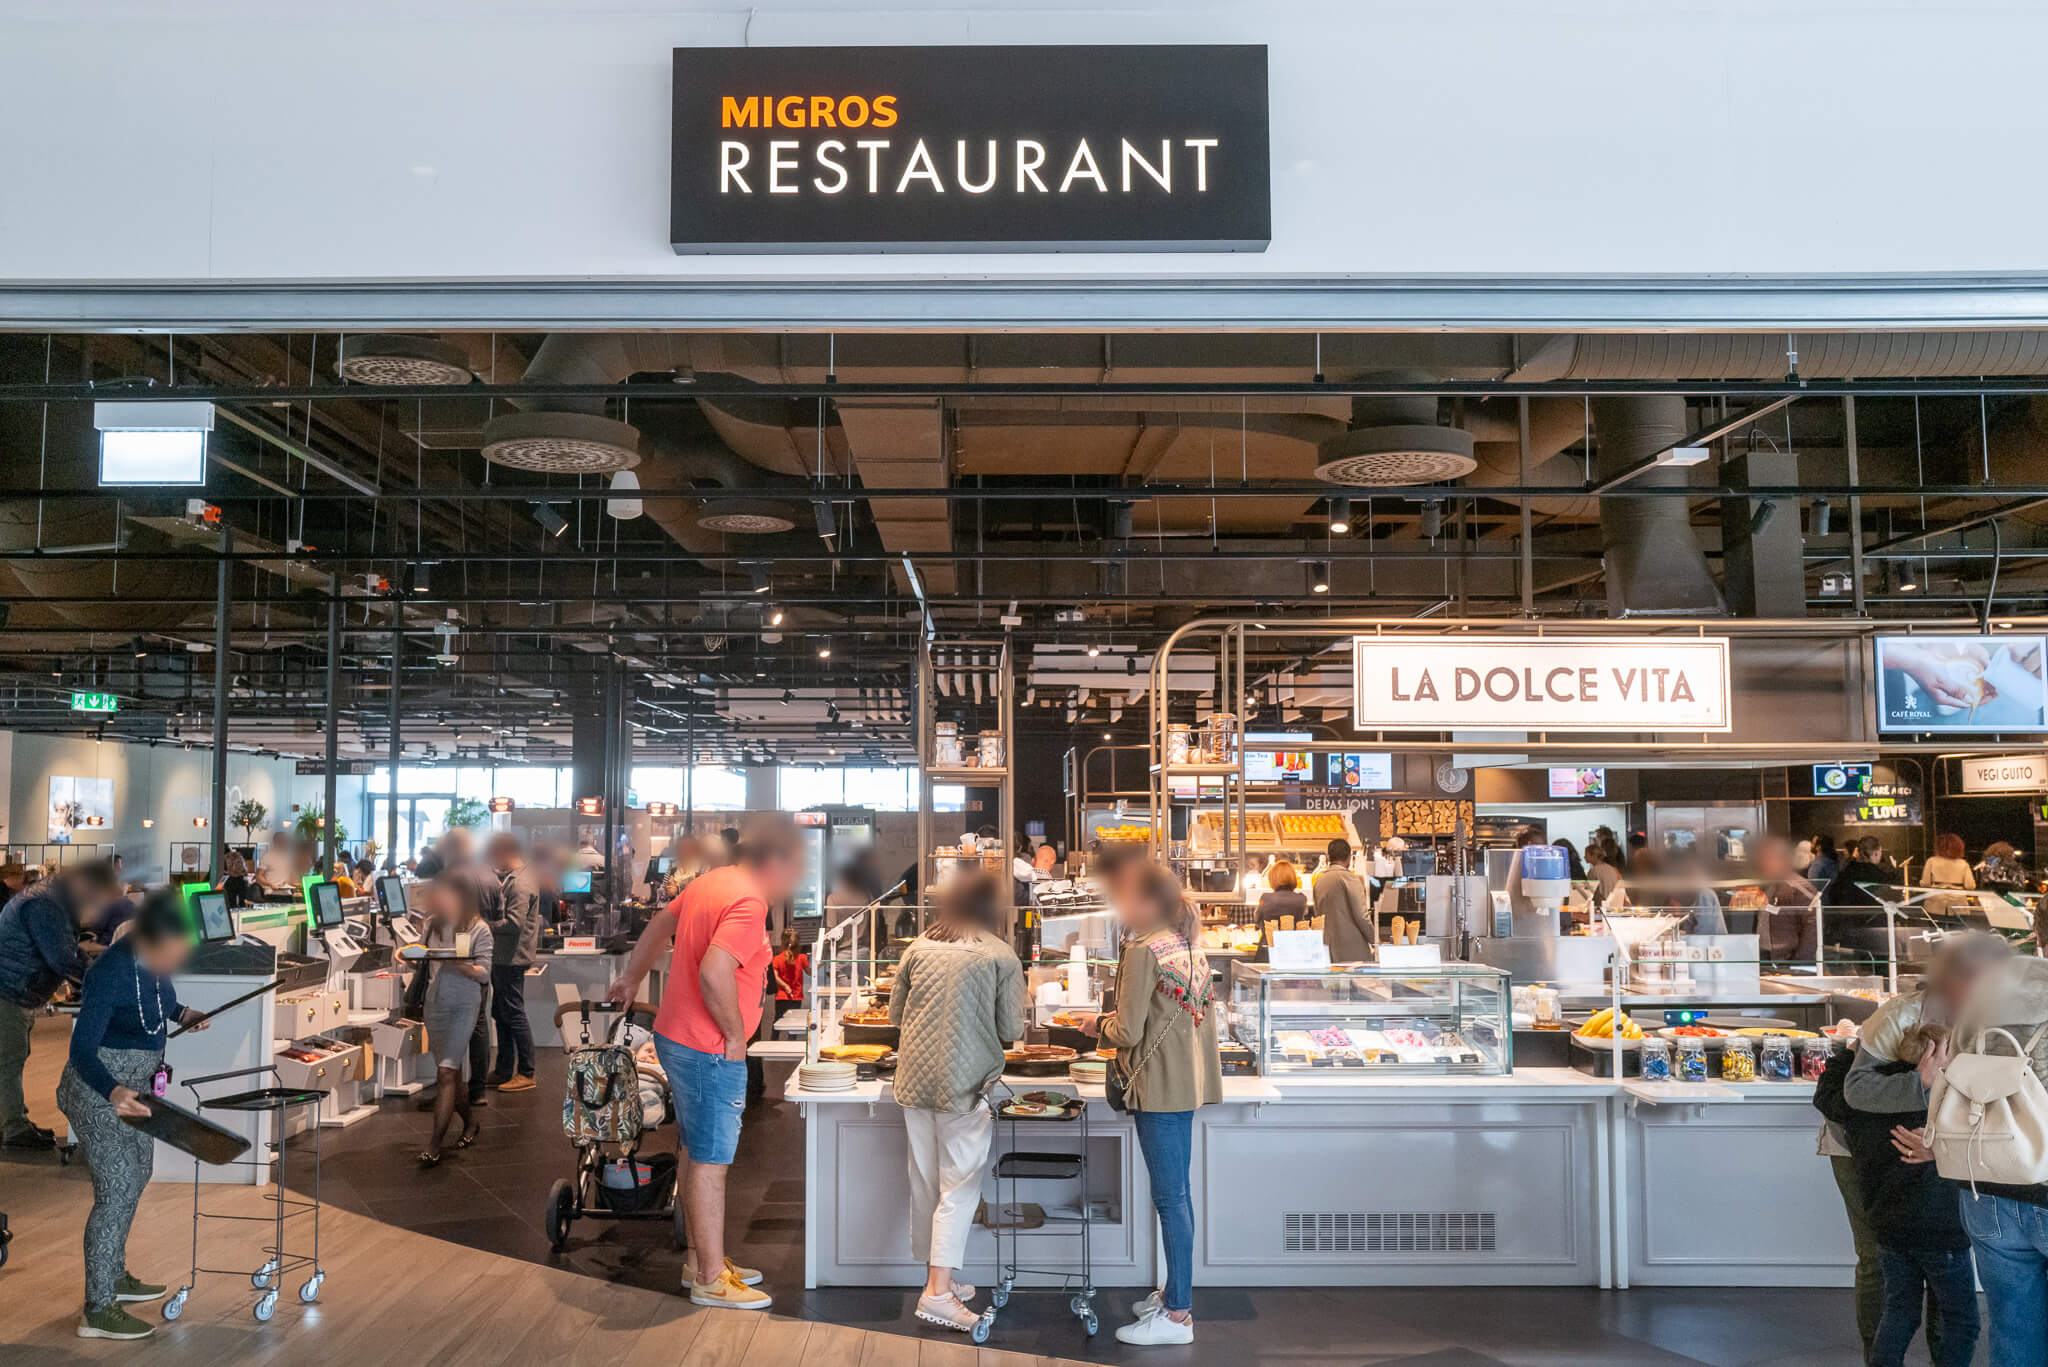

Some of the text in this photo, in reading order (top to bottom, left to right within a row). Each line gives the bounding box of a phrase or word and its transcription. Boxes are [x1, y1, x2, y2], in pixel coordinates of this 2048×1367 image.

[721, 94, 898, 129] MIGROS
[719, 137, 1218, 194] RESTAURANT
[1391, 666, 1696, 703] LA DOLCE VITA
[1891, 710, 1908, 718] CAFÉ
[1977, 766, 2033, 781] VEGI GUSTO
[1306, 799, 1375, 813] DE PASION!
[1859, 804, 1907, 820] V-LOVE
